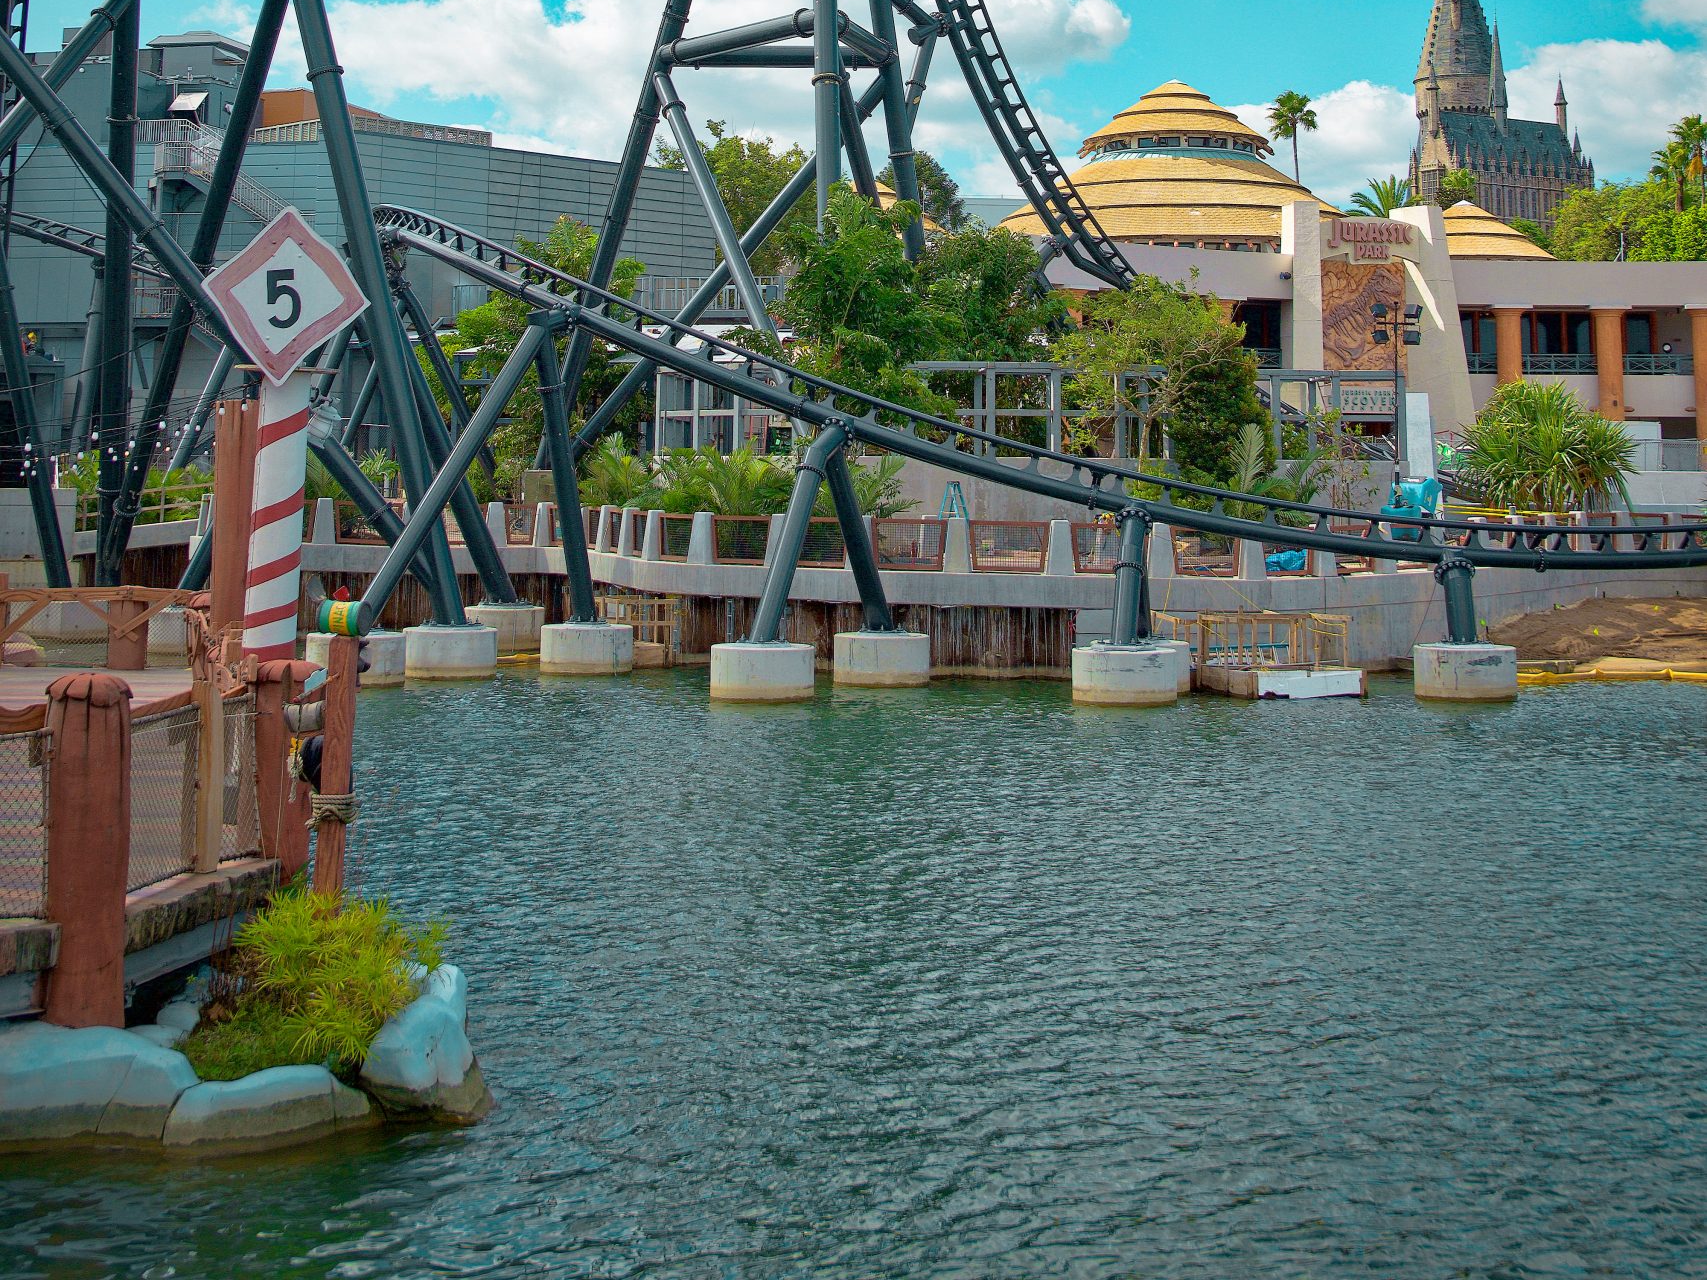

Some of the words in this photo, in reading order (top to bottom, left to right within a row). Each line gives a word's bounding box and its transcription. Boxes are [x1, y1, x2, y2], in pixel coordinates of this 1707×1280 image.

[1328, 219, 1413, 248] JURASSIC
[1354, 241, 1390, 261] PARK
[267, 269, 301, 328] 5
